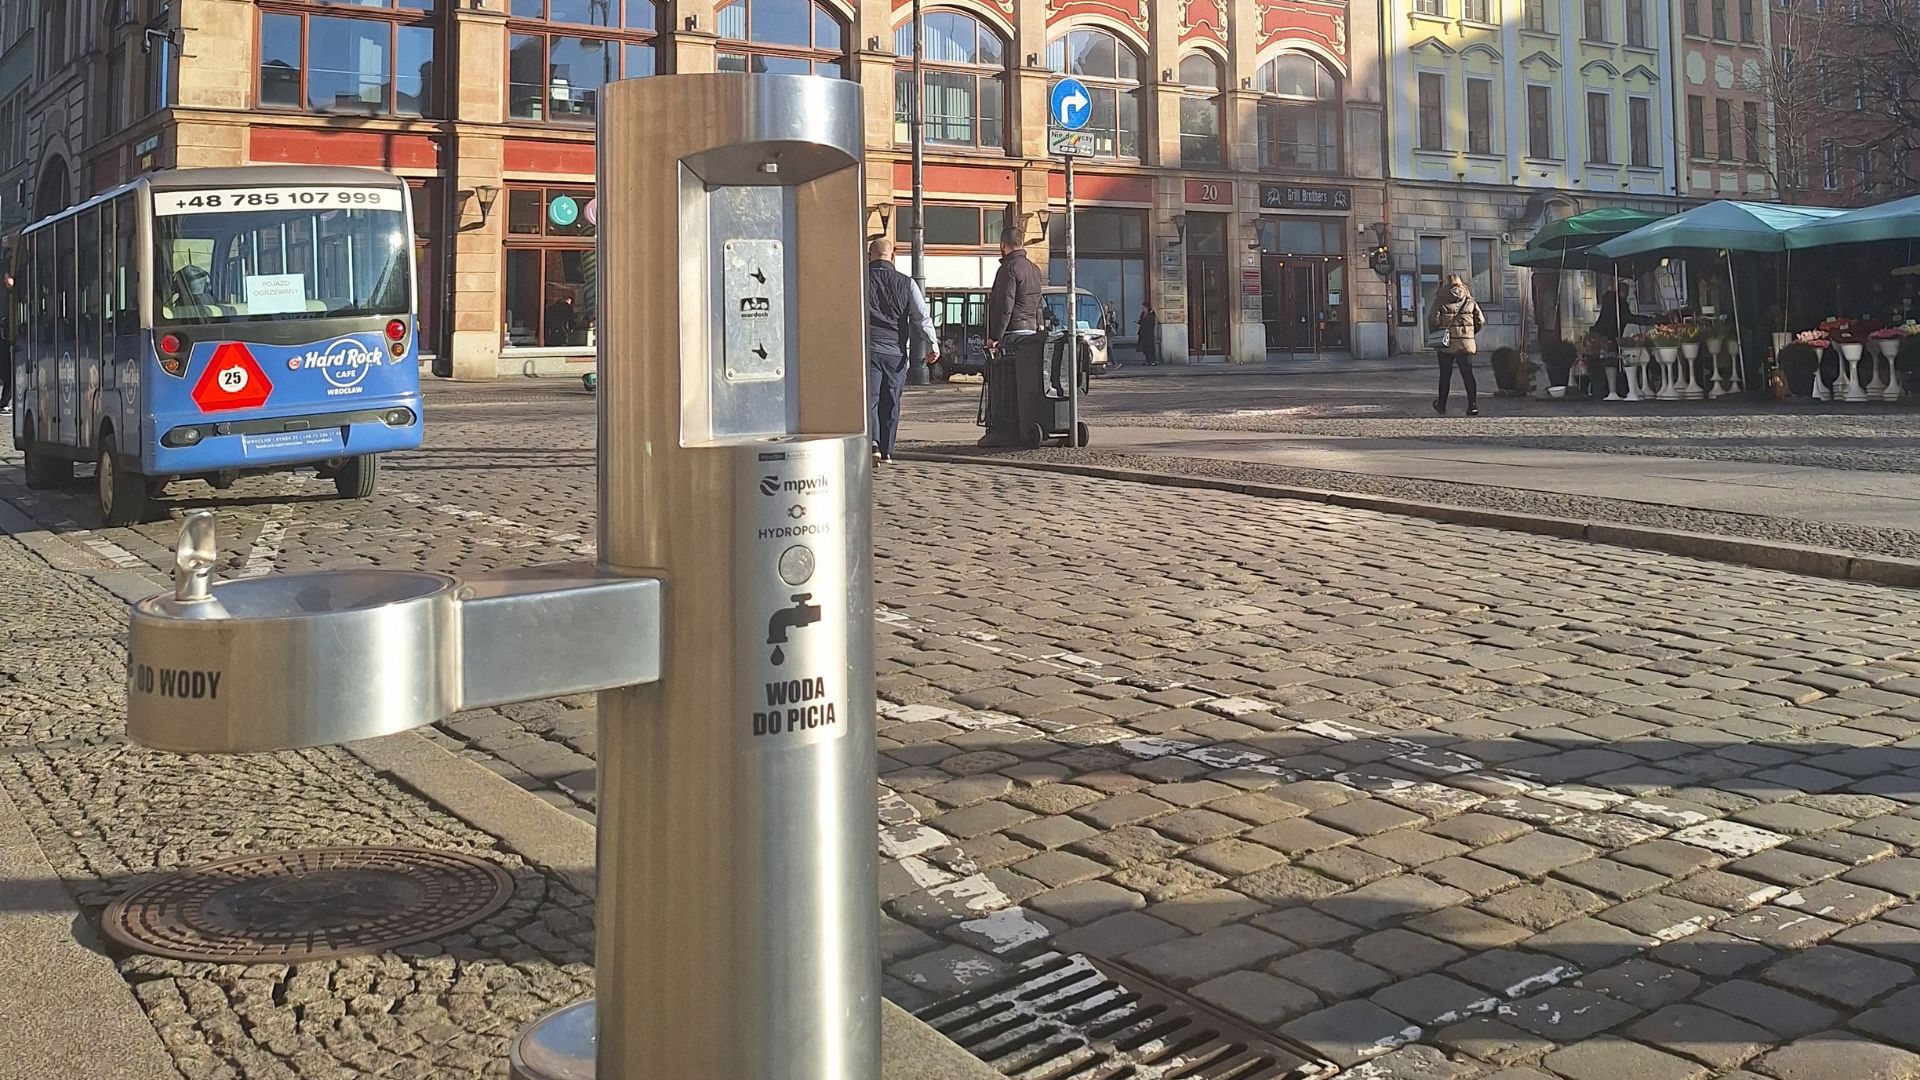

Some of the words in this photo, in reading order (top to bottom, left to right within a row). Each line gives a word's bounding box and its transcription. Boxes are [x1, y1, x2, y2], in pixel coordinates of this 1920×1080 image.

[176, 195, 222, 209] +48
[230, 193, 280, 206] 785
[288, 192, 330, 204] 107
[337, 192, 382, 204] 999
[1202, 184, 1218, 201] 20
[1287, 188, 1301, 201] Grill
[1301, 189, 1328, 203] Brothers
[304, 349, 346, 369] Hard
[347, 347, 383, 369] Rock
[224, 371, 241, 385] 25
[784, 475, 828, 494] mpwik
[758, 523, 830, 539] HYDROPOLIS
[160, 668, 222, 700] WODY
[766, 676, 825, 706] WODA
[753, 710, 782, 736] DO
[787, 702, 836, 732] PICIA
